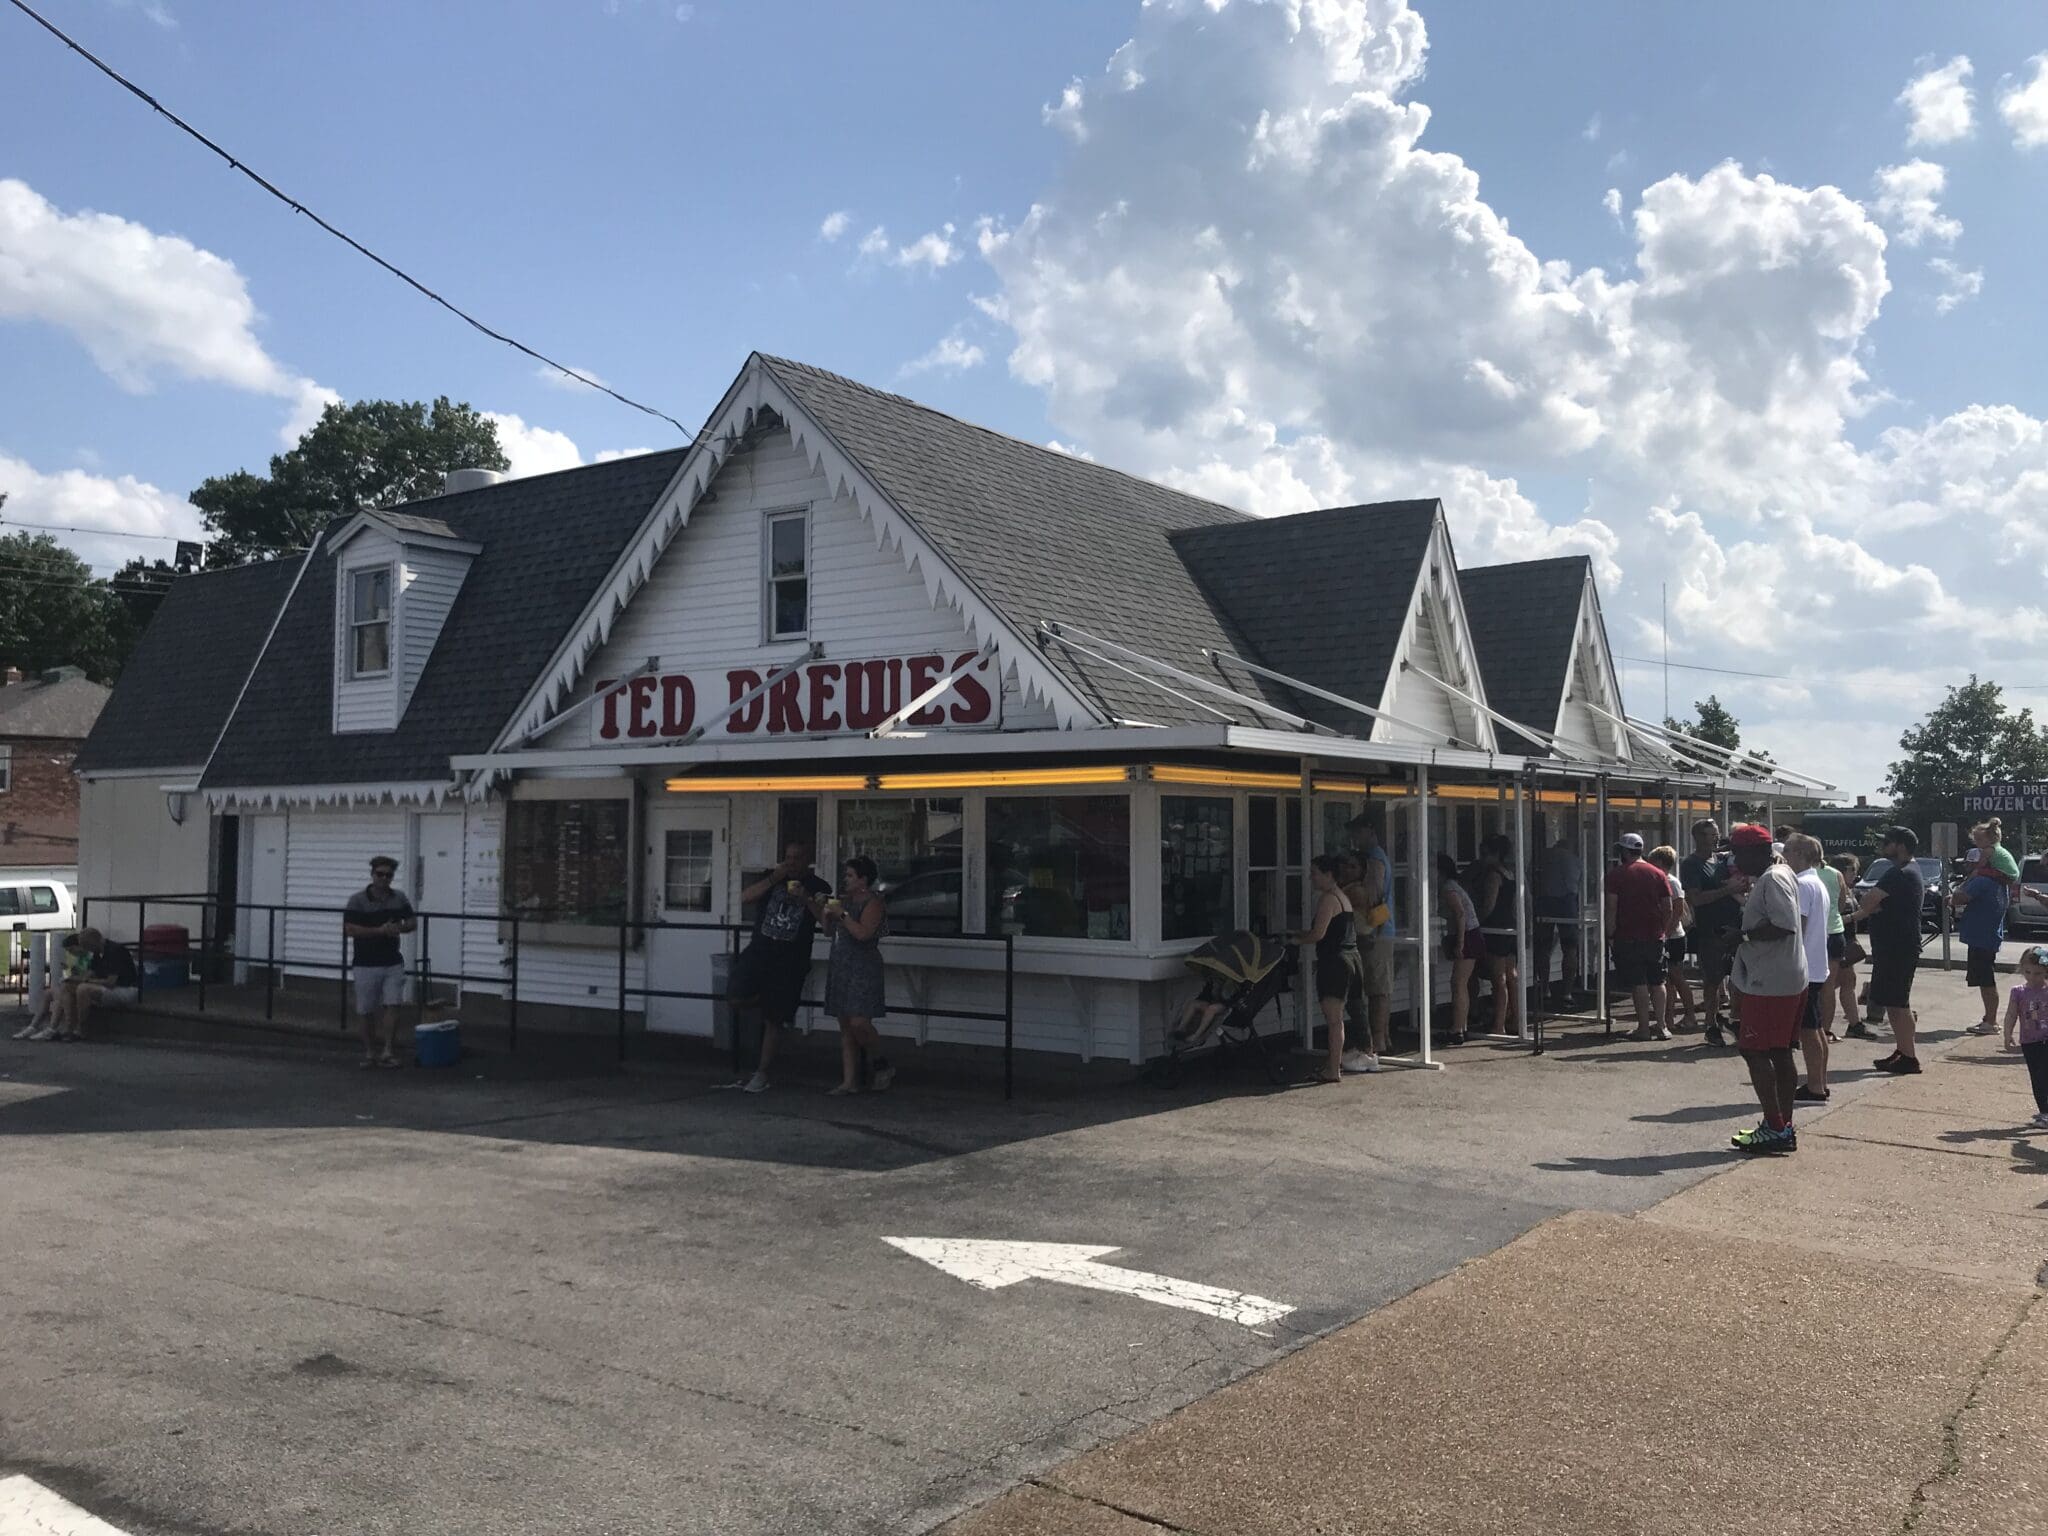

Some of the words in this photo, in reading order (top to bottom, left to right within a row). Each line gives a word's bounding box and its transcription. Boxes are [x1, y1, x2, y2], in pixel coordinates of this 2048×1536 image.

[595, 675, 695, 739] TED
[726, 651, 991, 733] DREWES
[1989, 785, 2015, 796] TED
[1963, 796, 2024, 812] FROZEN
[1825, 839, 1857, 847] TRAFFIC
